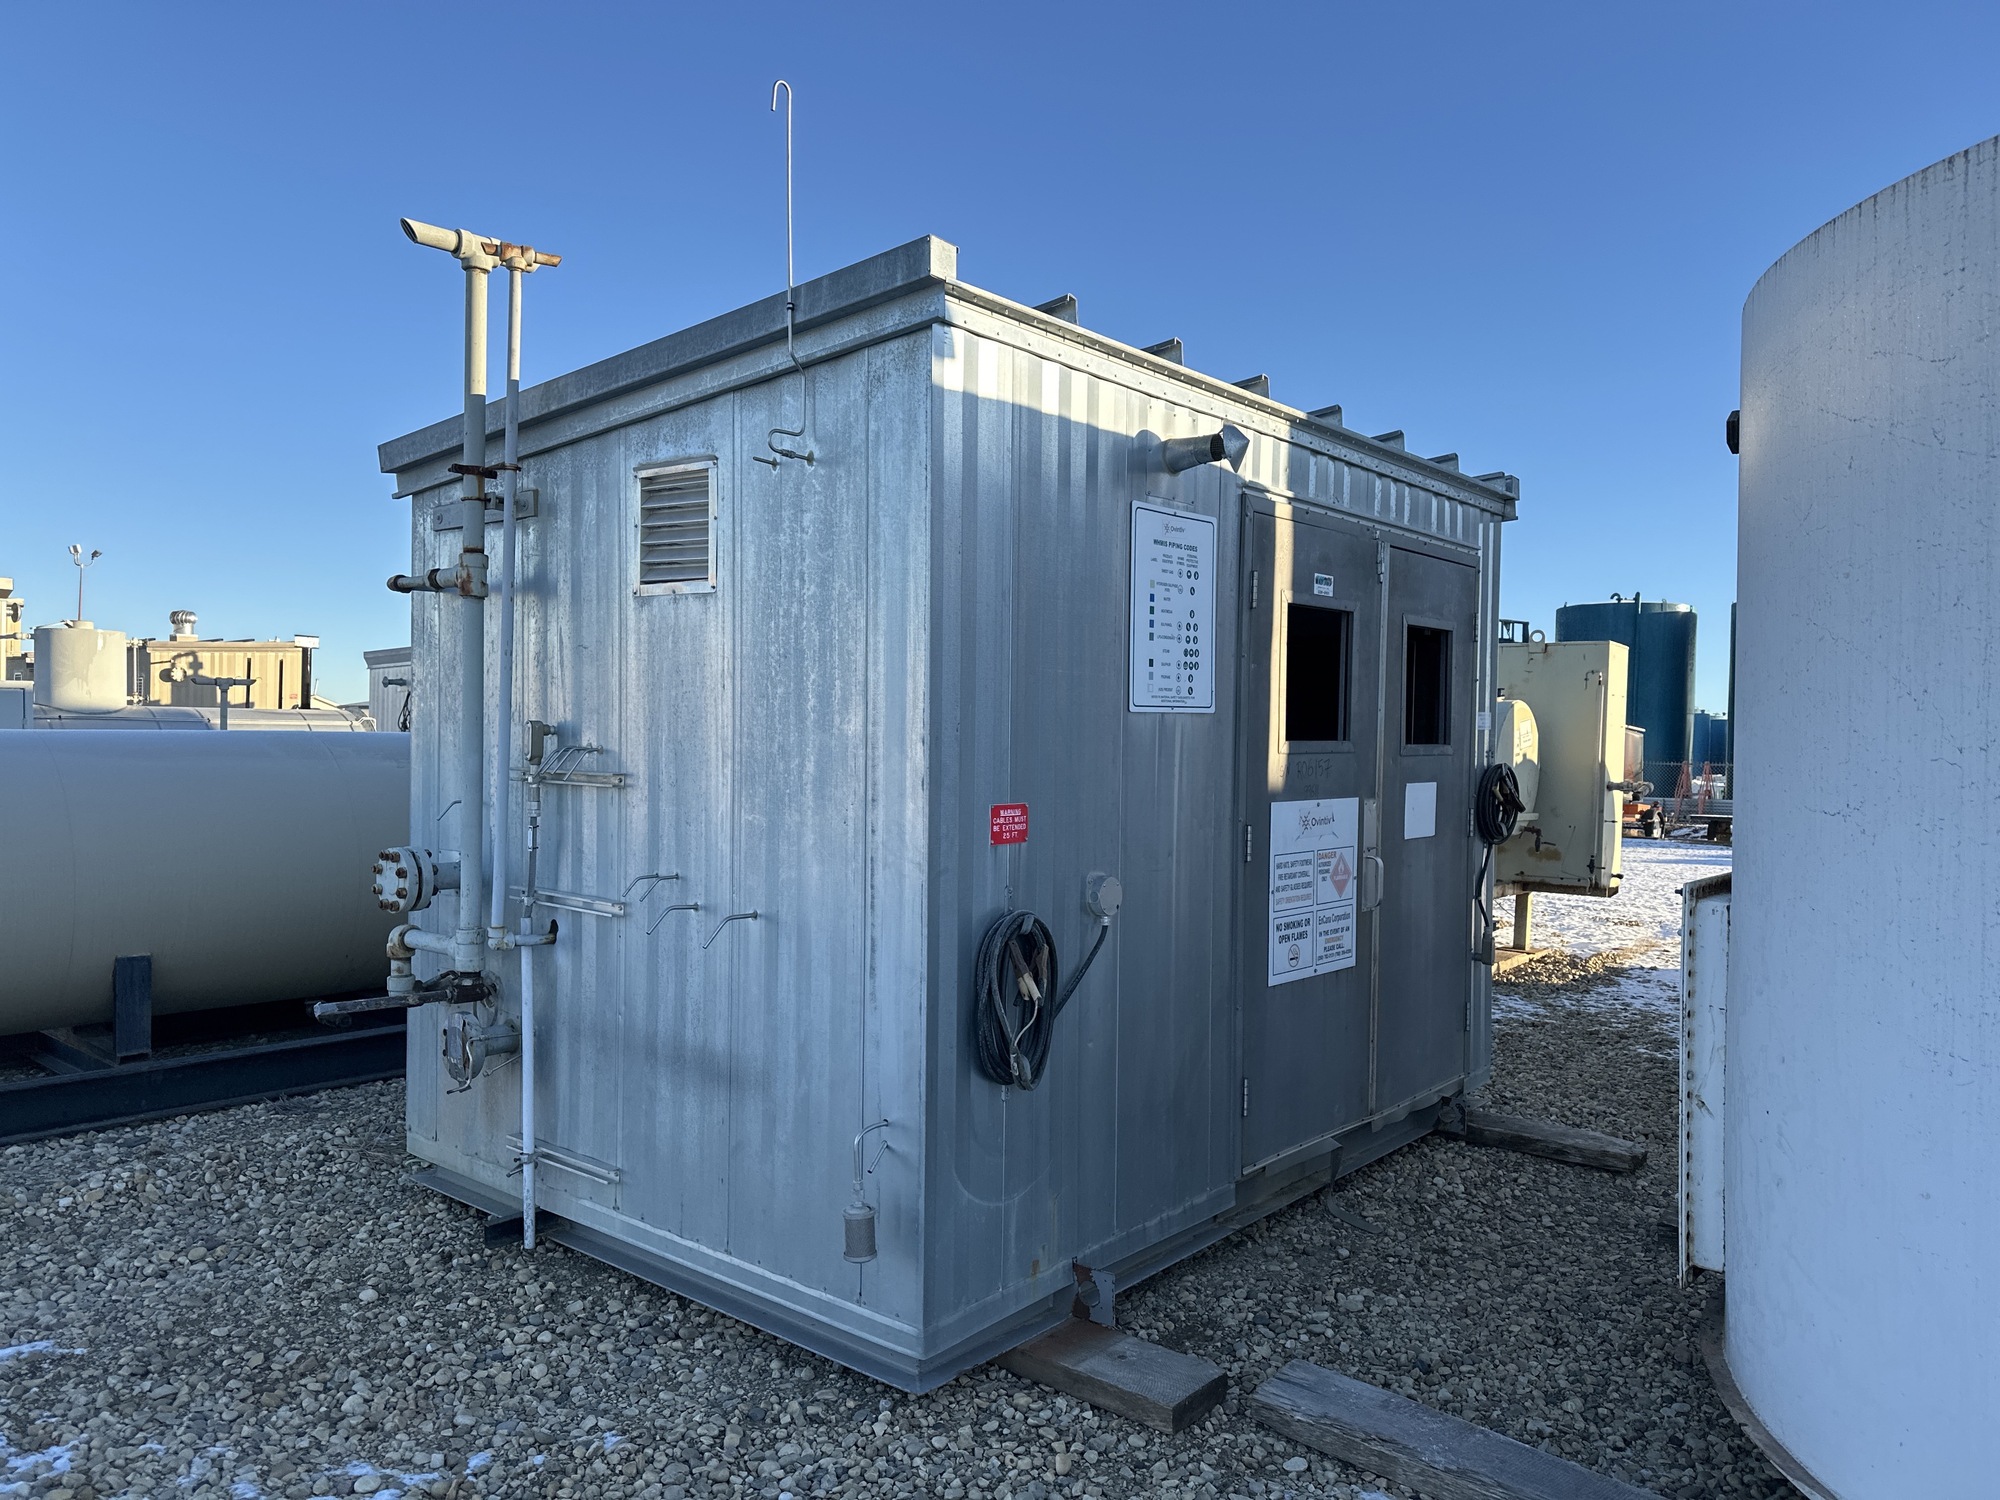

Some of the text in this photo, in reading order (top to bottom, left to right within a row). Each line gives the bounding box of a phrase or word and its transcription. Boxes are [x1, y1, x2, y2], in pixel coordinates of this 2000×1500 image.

[1153, 539, 1198, 552] WHMIS PIPING CODES
[1002, 823, 1026, 831] EXTENDED
[1311, 816, 1332, 827] Ovintiv
[1318, 851, 1337, 860] DANGER
[1331, 912, 1351, 925] Corporation
[1276, 918, 1311, 932] NO SMOKING OR
[1278, 930, 1308, 944] OPEN FLAMES
[1323, 944, 1335, 952] PLEASE
